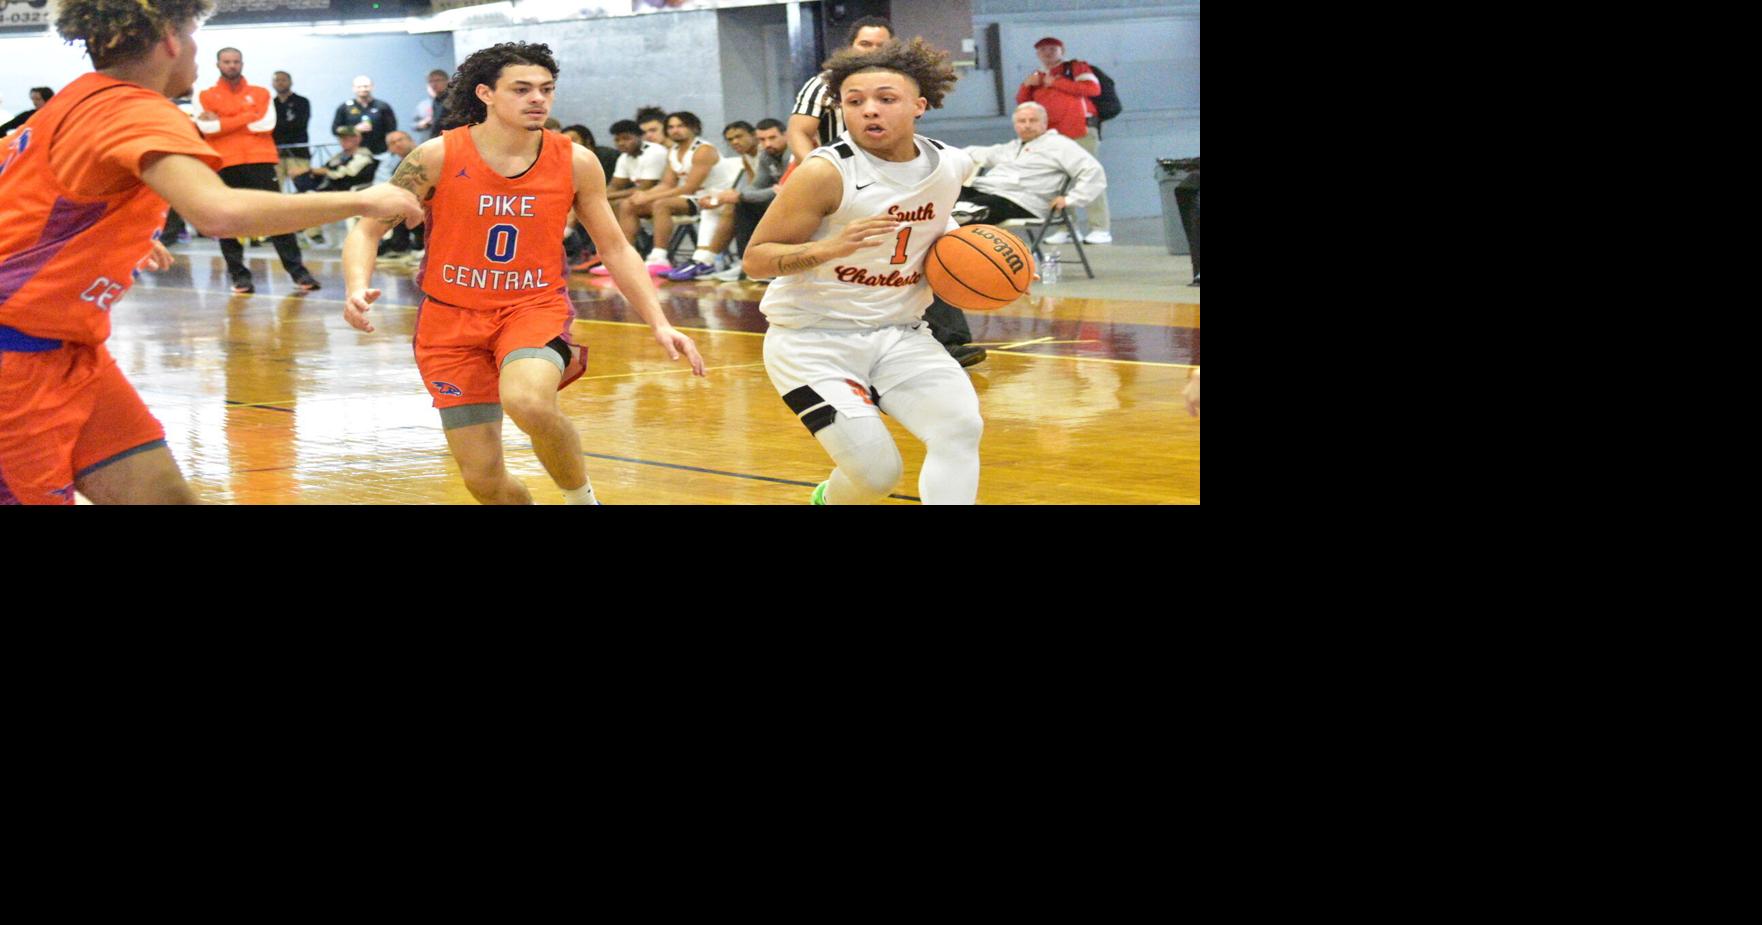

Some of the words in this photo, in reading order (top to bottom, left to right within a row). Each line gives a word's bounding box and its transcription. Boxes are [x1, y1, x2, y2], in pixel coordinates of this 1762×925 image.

[478, 194, 536, 217] PIKE
[888, 202, 935, 222] South
[484, 223, 519, 264] 0
[890, 226, 912, 265] 1
[971, 227, 1024, 274] Wilson
[80, 276, 124, 311] CE
[442, 263, 549, 290] CENTRAL
